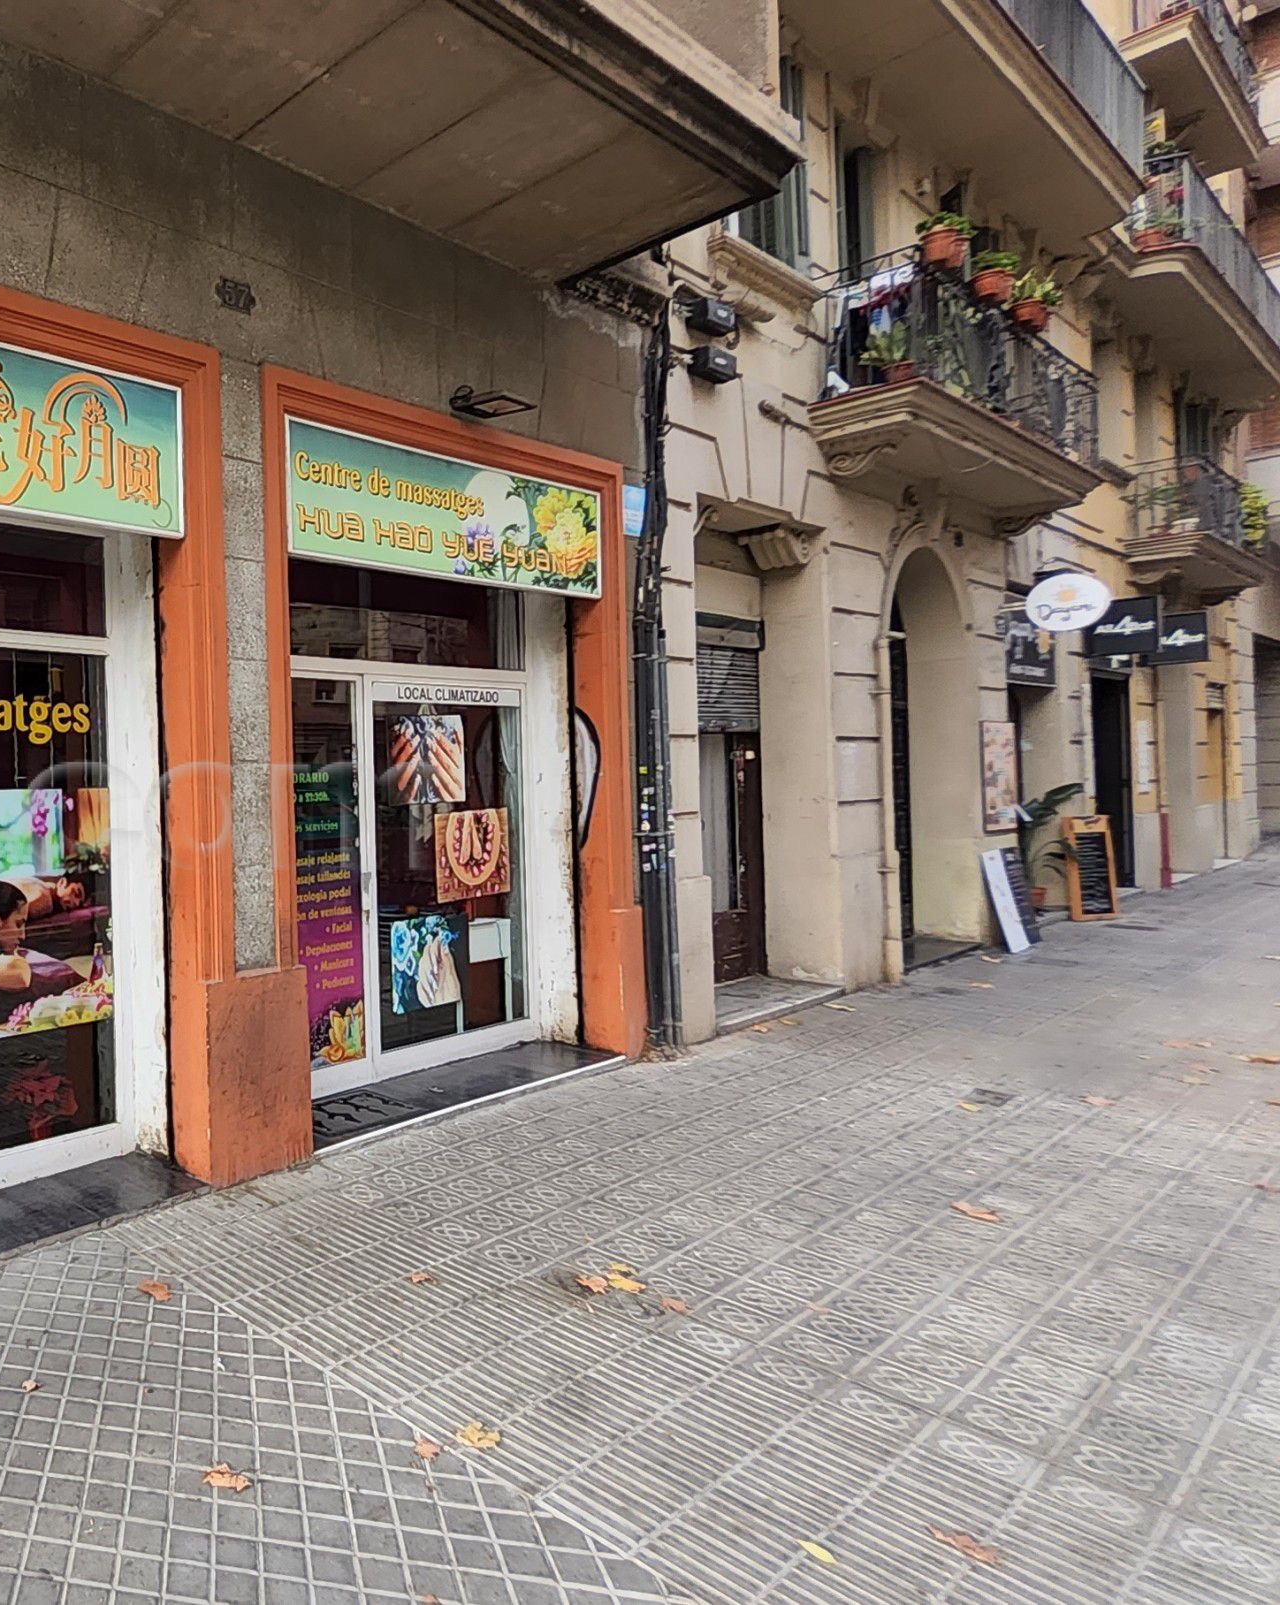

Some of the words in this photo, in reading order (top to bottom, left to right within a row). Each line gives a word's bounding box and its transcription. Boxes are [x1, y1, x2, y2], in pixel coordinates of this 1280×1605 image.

[225, 281, 249, 308] 57
[294, 450, 362, 492] Centre
[367, 465, 391, 497] de
[396, 478, 485, 521] massatges
[397, 686, 433, 700] LOCAL
[434, 688, 500, 704] CLIMATIZADO
[304, 819, 338, 833] servicios
[317, 851, 350, 865] relajante
[328, 885, 352, 901] podal
[308, 908, 319, 920] de
[320, 905, 353, 918] ventosas
[331, 920, 353, 935] Facial
[306, 940, 353, 957] Depilaciones
[320, 958, 354, 972] Manicura
[322, 975, 355, 990] Pedicura
